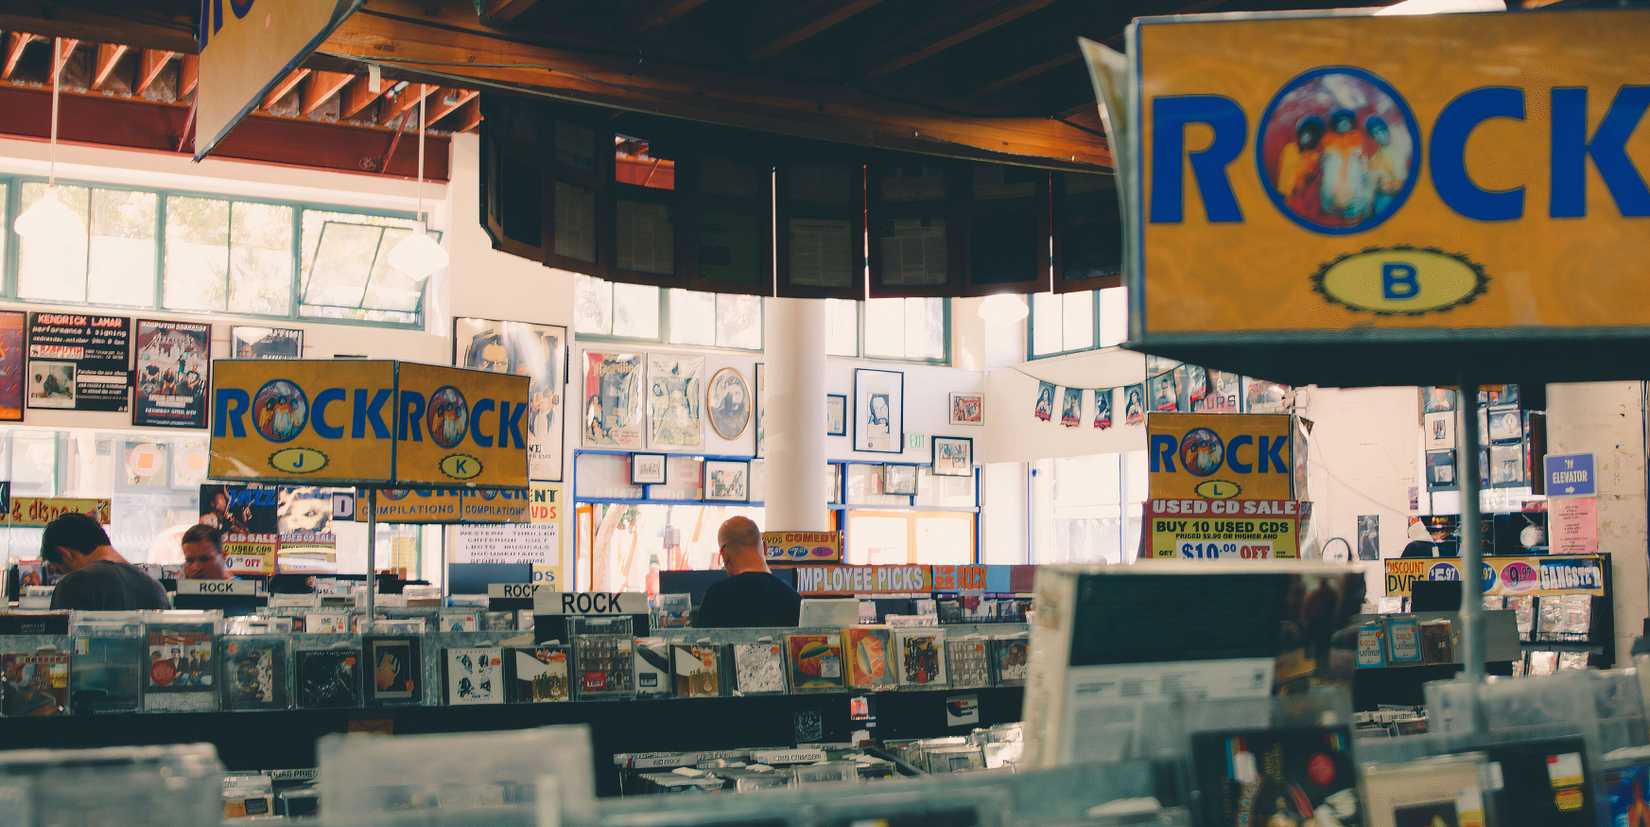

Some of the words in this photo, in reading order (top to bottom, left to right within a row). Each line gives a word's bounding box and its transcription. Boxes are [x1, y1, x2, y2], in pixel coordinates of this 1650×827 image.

[1150, 65, 1650, 235] ROCK
[1381, 263, 1421, 299] B
[38, 313, 87, 326] KENDRICK
[90, 317, 123, 328] LAMAR
[213, 379, 393, 443] ROCK
[398, 385, 530, 450] ROCK
[1150, 427, 1289, 477] ROCK
[292, 452, 304, 468] J
[456, 459, 468, 474] K
[1552, 470, 1588, 484] ELEVATOR
[1213, 484, 1223, 496] L
[361, 504, 454, 516] CMPILATIONS
[1152, 500, 1208, 514] USED
[1211, 501, 1241, 514] CD
[1244, 501, 1297, 515] SALE
[1156, 521, 1187, 533] BUY
[1192, 521, 1210, 533] 10
[1214, 521, 1255, 533] USED
[1259, 521, 1289, 533] CDS
[1181, 543, 1237, 559] $10.00
[1240, 545, 1271, 559] OFF
[1387, 561, 1425, 574] DISCOUNT
[877, 567, 924, 592] PICKS
[199, 582, 234, 593] ROCK
[504, 584, 540, 598] ROCK
[561, 592, 622, 614] ROCK
